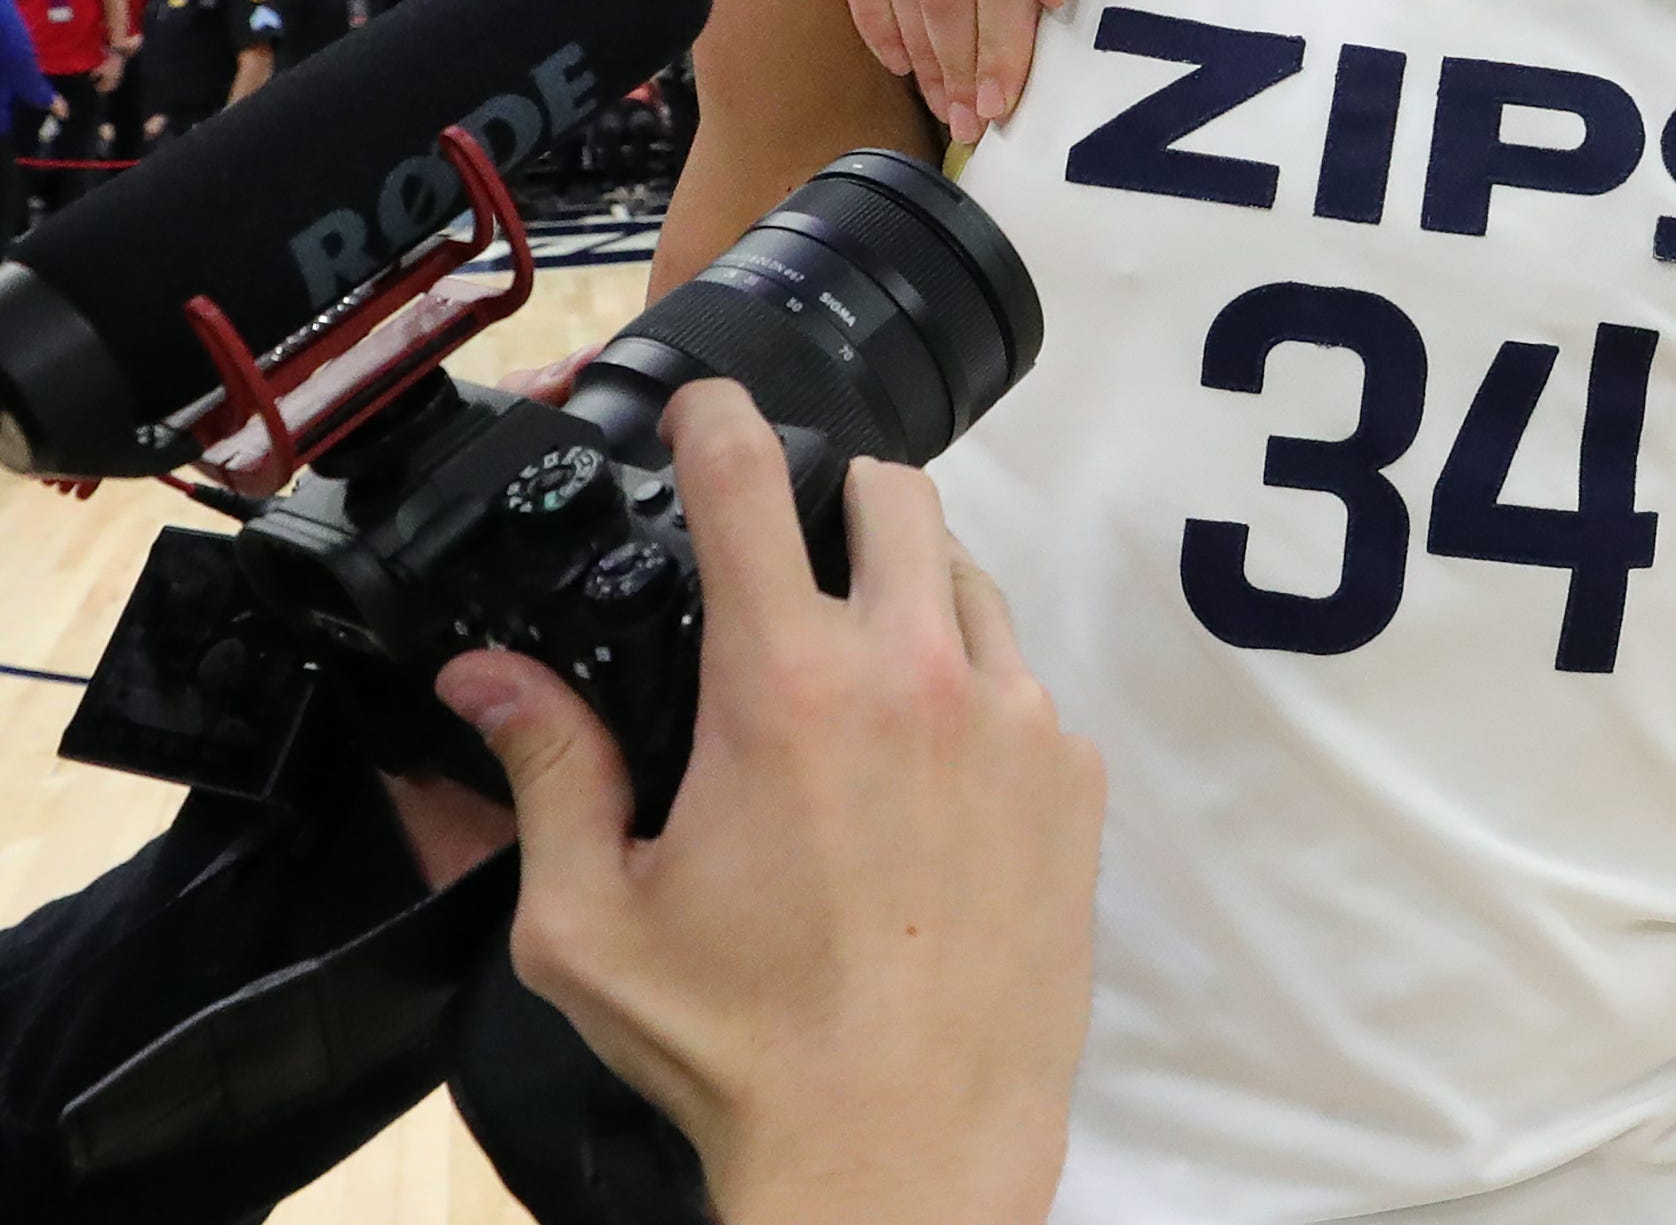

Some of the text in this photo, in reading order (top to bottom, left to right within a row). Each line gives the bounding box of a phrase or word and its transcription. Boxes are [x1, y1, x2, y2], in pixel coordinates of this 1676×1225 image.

[786, 296, 804, 313] 50
[818, 291, 857, 327] SIGMA
[838, 344, 854, 362] 70
[1179, 281, 1660, 674] 34
